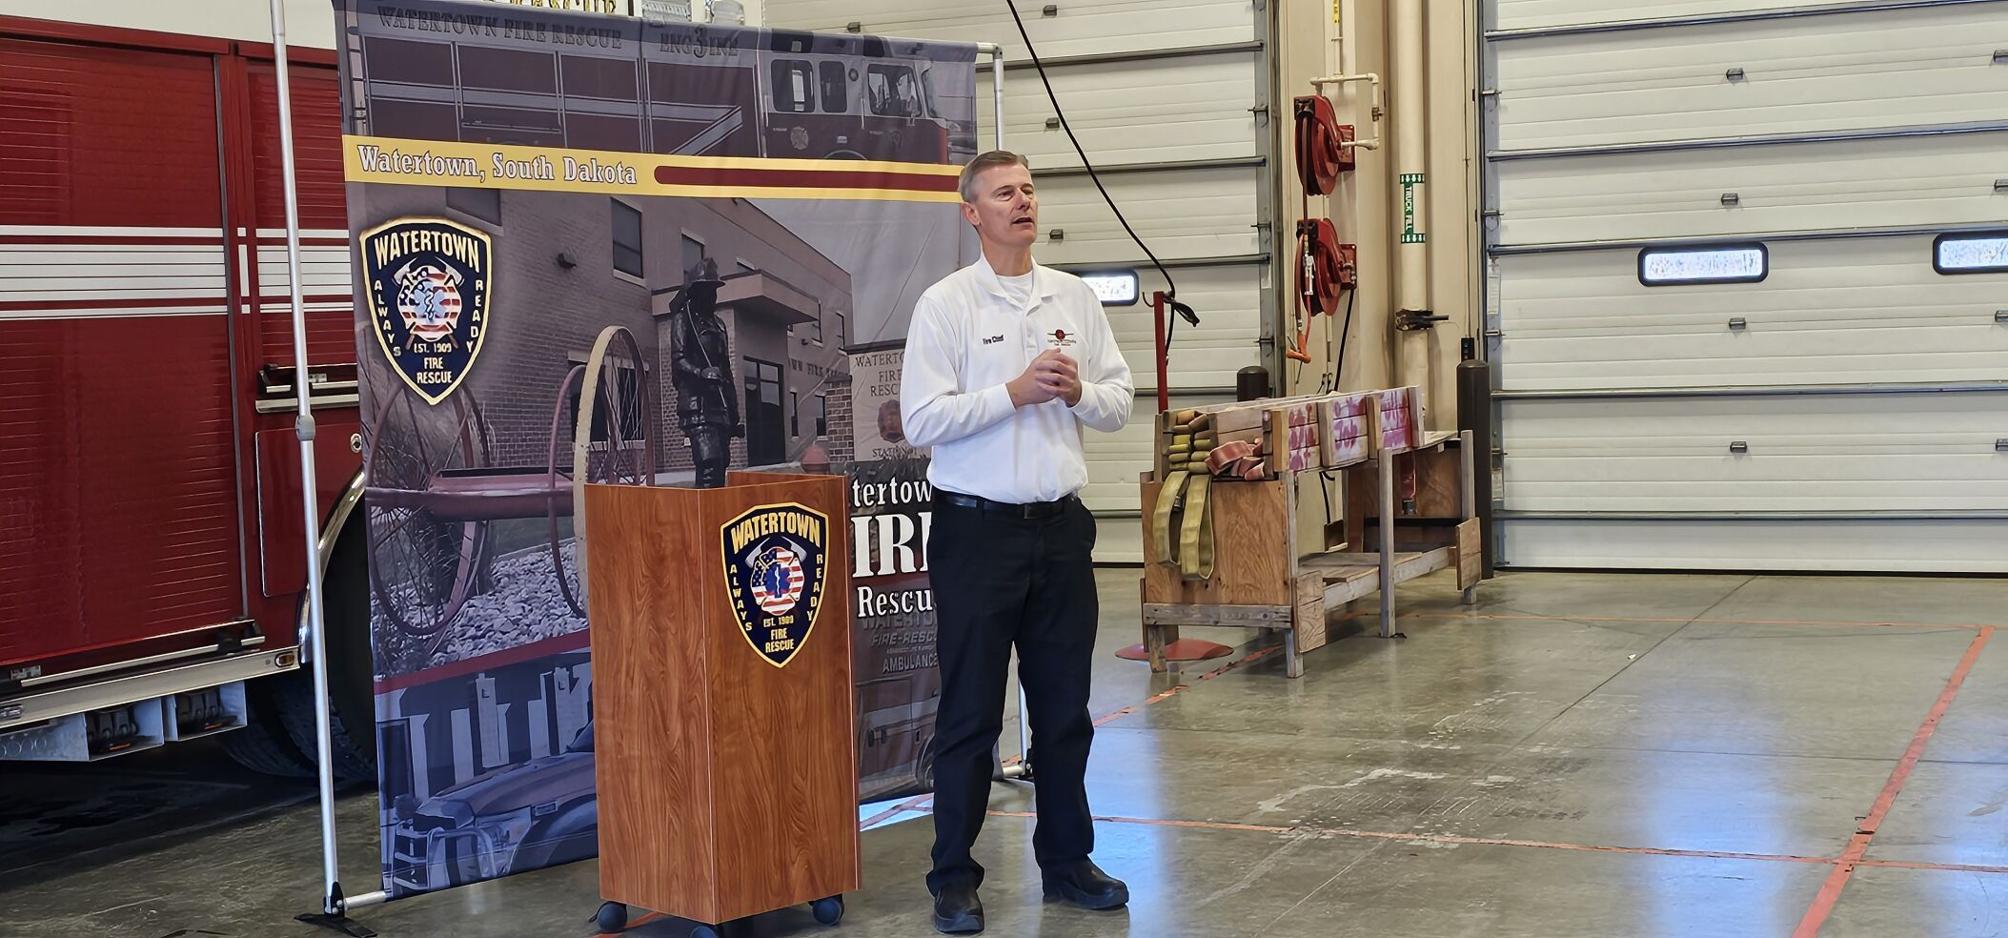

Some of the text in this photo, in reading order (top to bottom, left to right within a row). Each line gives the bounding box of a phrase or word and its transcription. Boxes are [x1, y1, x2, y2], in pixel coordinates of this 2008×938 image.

[377, 6, 498, 38] WATERTOWN
[504, 18, 546, 43] FIRE
[552, 24, 622, 50] RESCUE
[357, 145, 637, 185] Watertown, South Dakota
[374, 230, 480, 273] WATERTOWN
[433, 343, 453, 353] 1909
[424, 357, 444, 370] FIRE
[416, 371, 452, 384] RESCUE
[870, 383, 898, 396] RESC
[852, 476, 933, 507] tertow
[731, 511, 821, 555] WATERTOWN
[851, 511, 932, 578] IR
[857, 586, 934, 618] Rescu
[763, 618, 775, 628] EST.
[770, 627, 787, 640] FIRE
[765, 639, 795, 653] RESCUE
